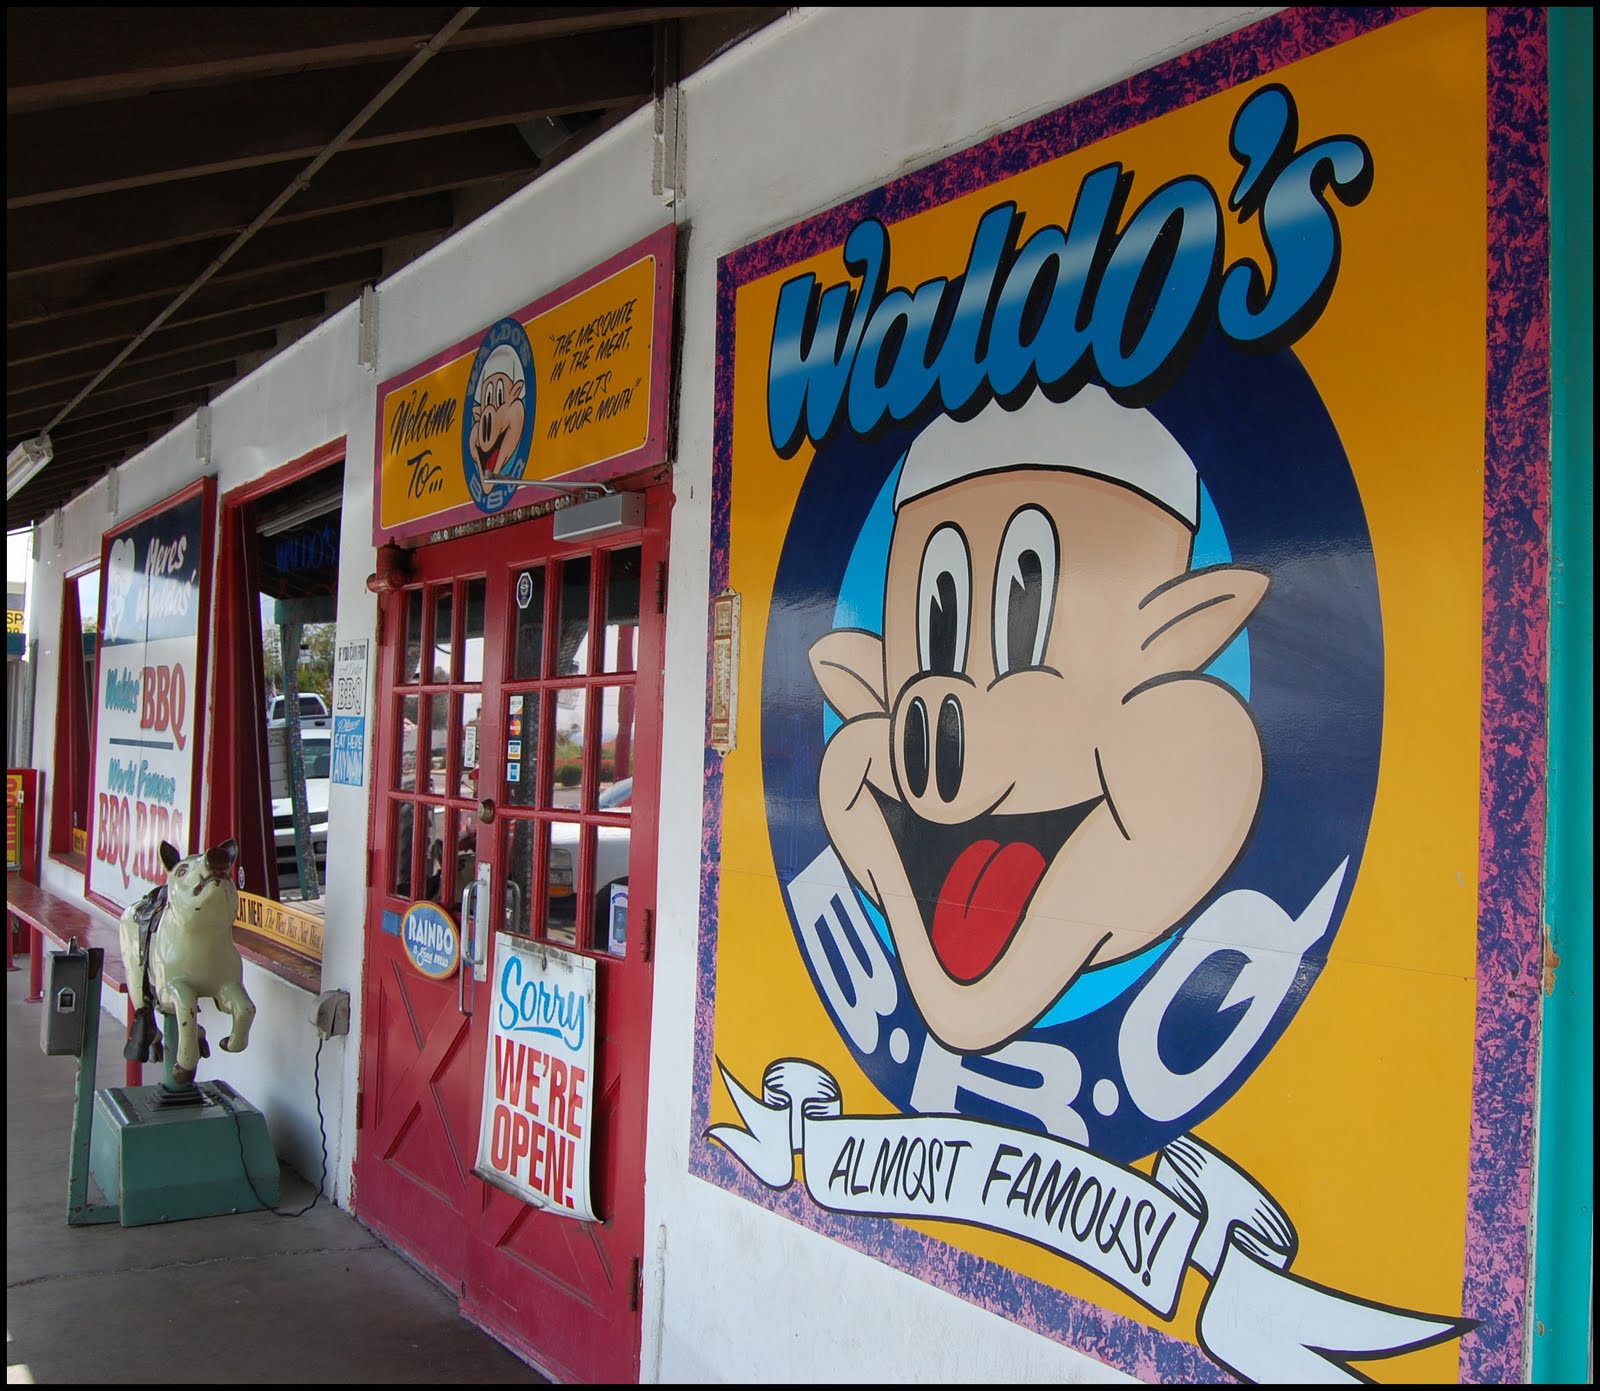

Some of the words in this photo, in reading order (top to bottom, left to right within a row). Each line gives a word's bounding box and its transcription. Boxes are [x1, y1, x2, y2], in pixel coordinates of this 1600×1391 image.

[766, 82, 1375, 460] Waldo's
[575, 298, 638, 348] MESQUITE
[550, 358, 567, 384] IN
[569, 344, 594, 375] THE
[563, 370, 613, 412] MELTS
[390, 389, 457, 456] Welcome
[547, 417, 562, 440] IN
[562, 406, 593, 436] YOUR
[7, 611, 25, 625] SP
[139, 662, 187, 751] BBQ
[334, 733, 347, 748] EAT
[347, 734, 363, 750] HERE
[108, 757, 137, 795] World
[137, 759, 176, 806] Famous
[96, 792, 131, 889] BBQ
[247, 898, 263, 929] MEAT
[408, 913, 454, 955] RAINBO
[499, 955, 585, 1052] Sorry
[494, 1034, 586, 1139] WE'RE
[490, 1103, 576, 1210] OPEN!
[828, 1136, 973, 1204] ALMOST
[981, 1151, 1179, 1288] FAMOUS!
